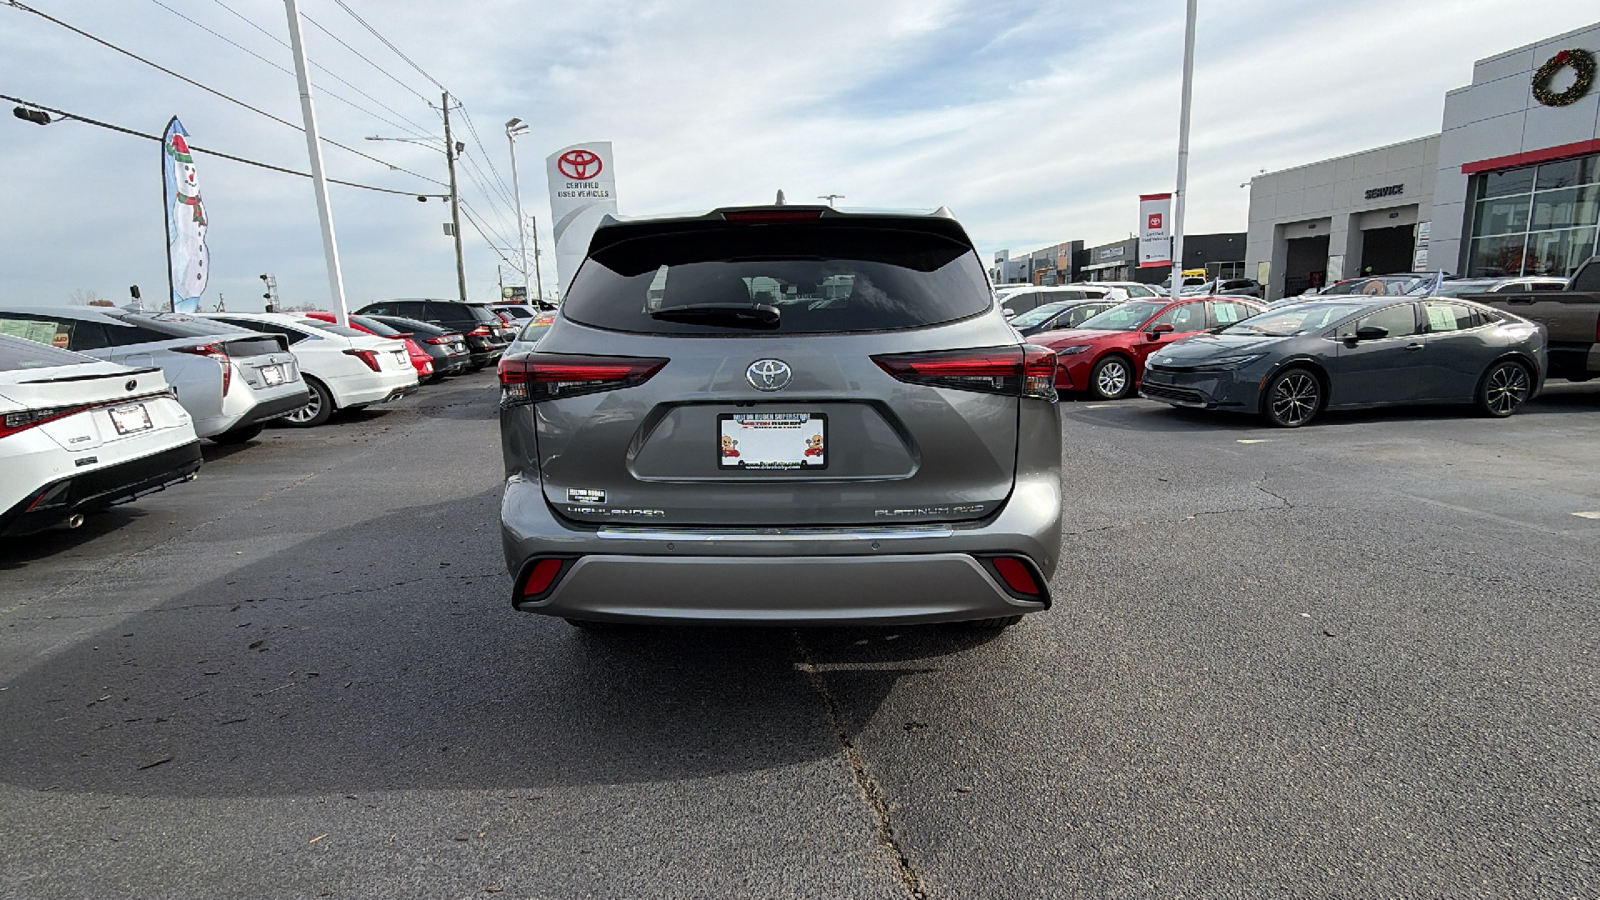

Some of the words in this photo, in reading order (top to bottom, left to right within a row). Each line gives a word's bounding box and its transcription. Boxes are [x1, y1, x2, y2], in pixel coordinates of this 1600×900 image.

[557, 190, 576, 198] USED
[577, 190, 609, 198] VEHICLES
[1364, 183, 1404, 200] SERVICE
[774, 413, 811, 421] SUPERSTORE
[567, 506, 666, 518] HIGHLANDER
[874, 507, 949, 517] PLATINUM
[953, 504, 984, 514] AWD
